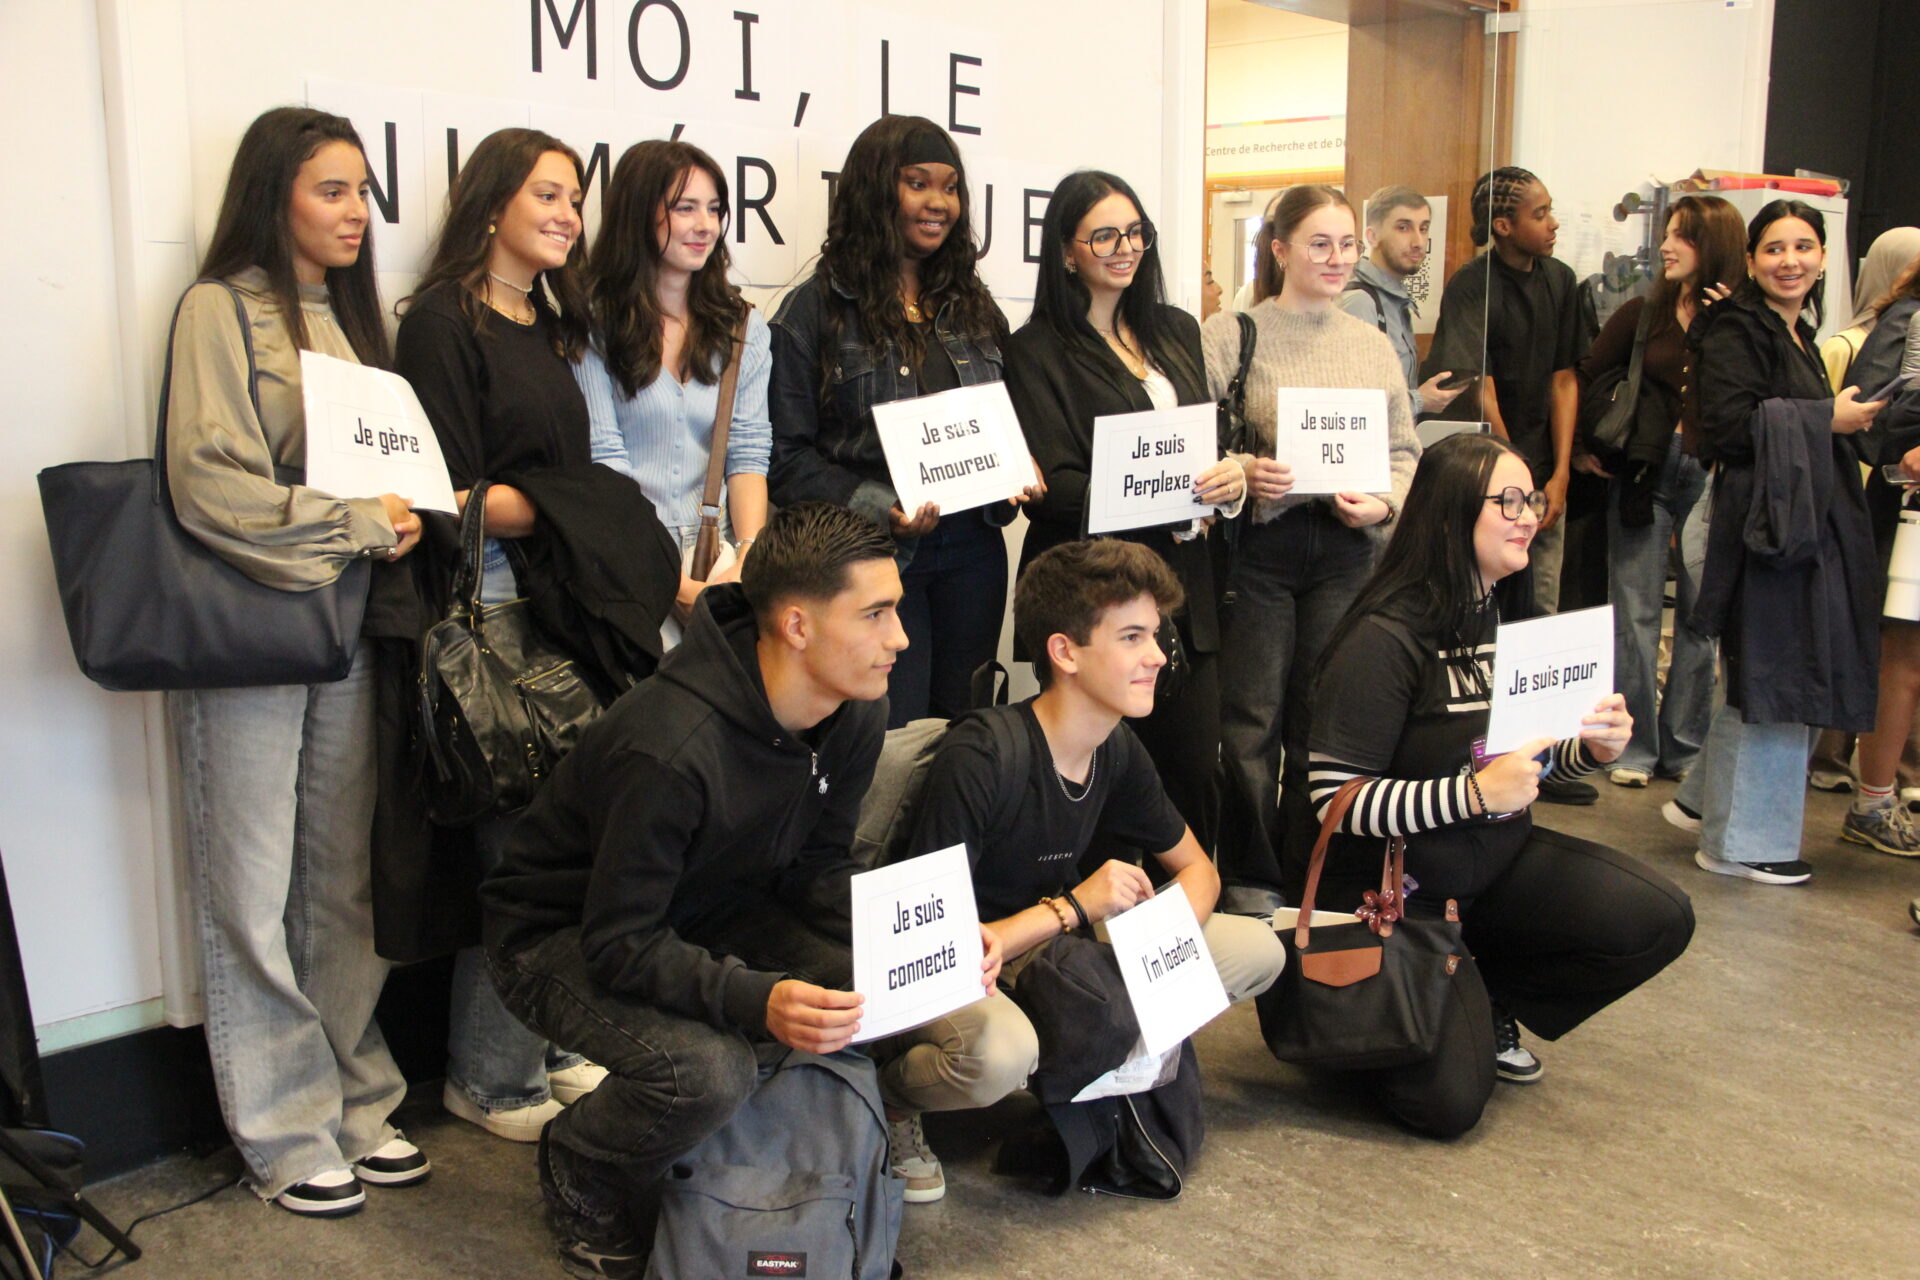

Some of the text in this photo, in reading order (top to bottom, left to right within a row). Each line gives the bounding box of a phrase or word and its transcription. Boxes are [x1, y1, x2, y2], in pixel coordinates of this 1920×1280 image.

[1205, 145, 1236, 157] Centre
[1239, 143, 1251, 155] de
[1253, 140, 1306, 153] Recherche
[1307, 140, 1318, 151] et
[1320, 138, 1333, 149] de
[921, 421, 942, 446] Je
[1300, 409, 1367, 431] Je suis en
[354, 417, 419, 456] Je gère
[1132, 433, 1185, 459] Je suis
[1322, 443, 1344, 464] PLS
[1123, 469, 1191, 499] Perplexe
[1508, 661, 1598, 696] Je suis pour
[893, 893, 945, 935] Je suis
[888, 940, 957, 991] connecté
[1141, 935, 1201, 983] I'm loading
[756, 1259, 798, 1268] EASTPAK
